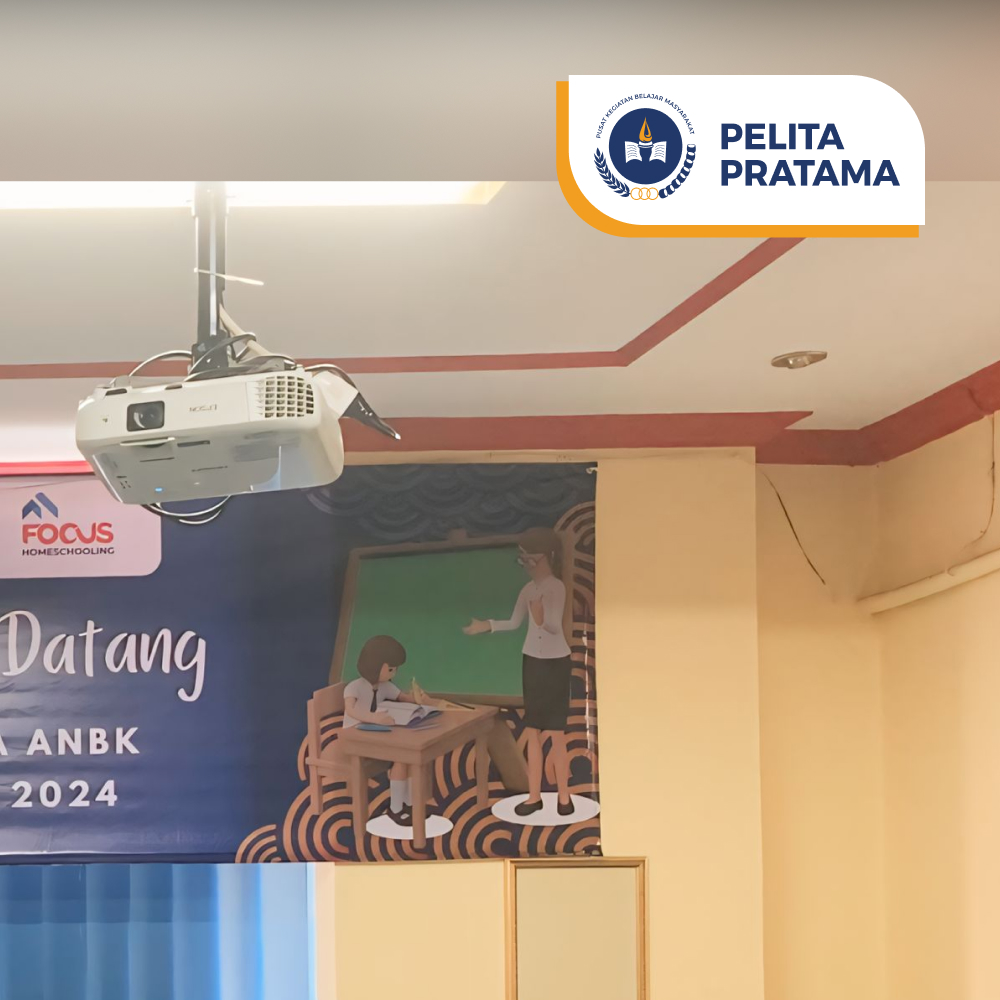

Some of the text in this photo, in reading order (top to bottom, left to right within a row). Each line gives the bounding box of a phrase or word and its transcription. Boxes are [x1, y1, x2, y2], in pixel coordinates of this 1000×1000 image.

[21, 522, 115, 545] FOCUS
[21, 546, 115, 556] HOMESCHOOLING
[26, 726, 141, 756] ANBK
[10, 779, 119, 808] 2024
